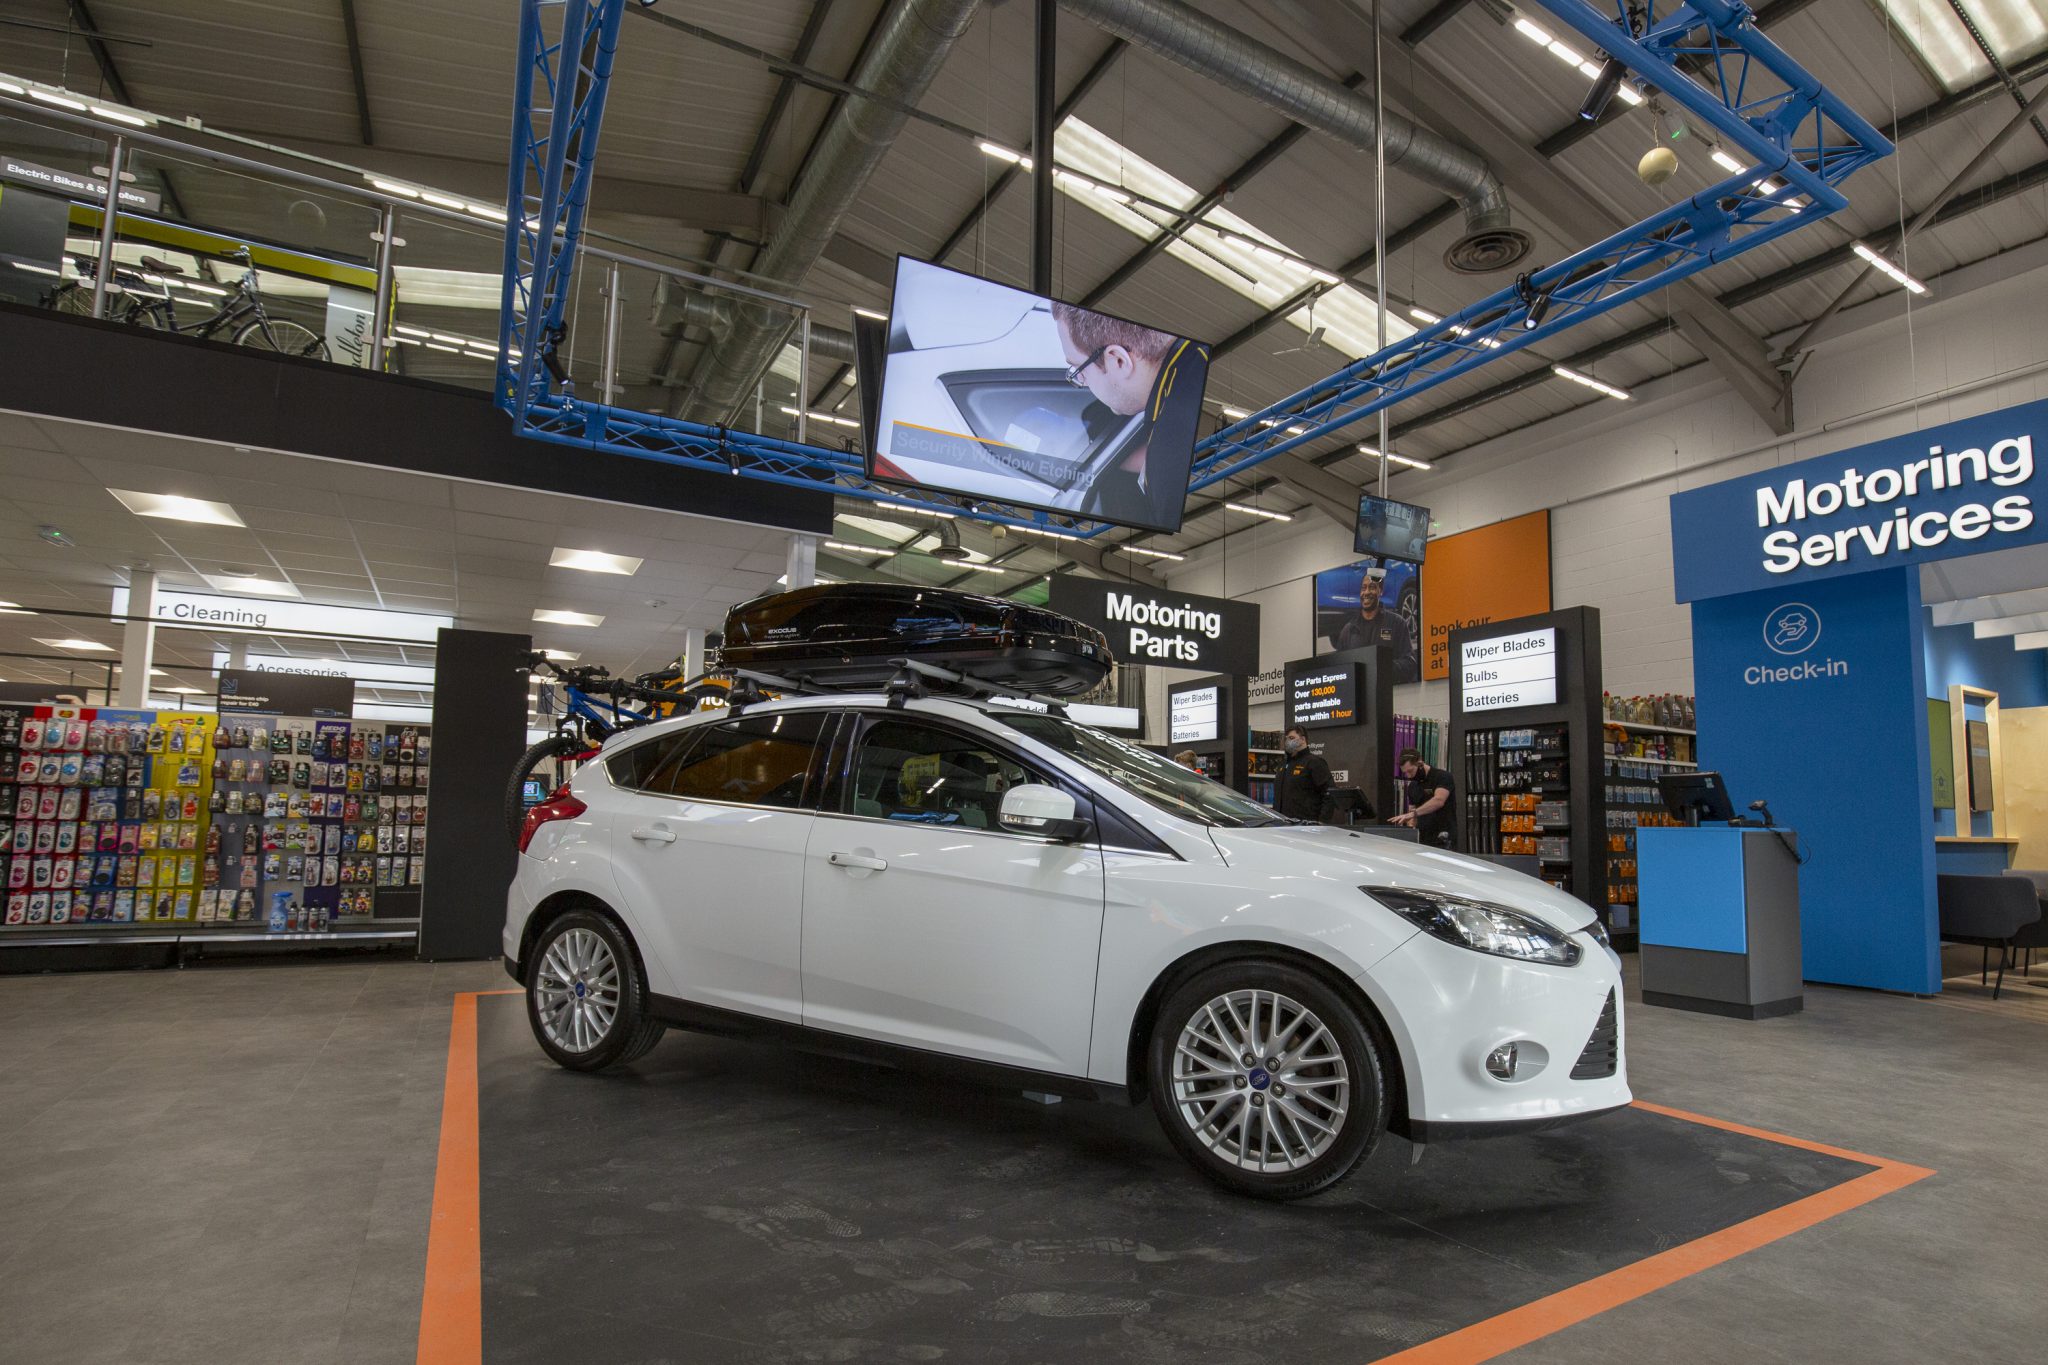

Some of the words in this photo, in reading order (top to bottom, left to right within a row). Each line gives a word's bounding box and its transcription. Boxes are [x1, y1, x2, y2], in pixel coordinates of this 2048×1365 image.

[7, 163, 51, 181] Electric
[53, 174, 85, 189] Bikes
[86, 183, 95, 192] &
[97, 186, 147, 204] Soters
[897, 431, 973, 460] Security
[973, 446, 1035, 472] Window
[1038, 459, 1096, 486] Etching
[1756, 435, 2034, 528] Motoring
[1762, 494, 2034, 574] Services
[174, 603, 268, 627] Cleaning
[1105, 592, 1222, 639] Motoring
[1430, 620, 1463, 638] book
[1129, 627, 1199, 662] Parts
[1430, 641, 1448, 656] ga
[1465, 646, 1500, 659] Wiper
[1503, 637, 1546, 653] Blades
[1248, 668, 1285, 685] epende
[1294, 679, 1306, 688] Car
[1306, 676, 1322, 686] Parts
[1322, 672, 1347, 684] Express
[1465, 671, 1498, 684] Bulbs
[1743, 658, 1849, 686] Check-in
[1173, 696, 1190, 705] Wiper
[1191, 692, 1213, 703] Blades
[1294, 689, 1310, 699] Over
[1311, 685, 1336, 697] 130,000
[1466, 692, 1520, 708] Batteries
[1294, 701, 1312, 713] parts
[1312, 697, 1341, 709] available
[1173, 713, 1190, 723] Bulbs
[1294, 714, 1309, 724] here
[1309, 711, 1330, 721] within
[1336, 709, 1352, 718] hour
[1172, 730, 1200, 740] Batteries
